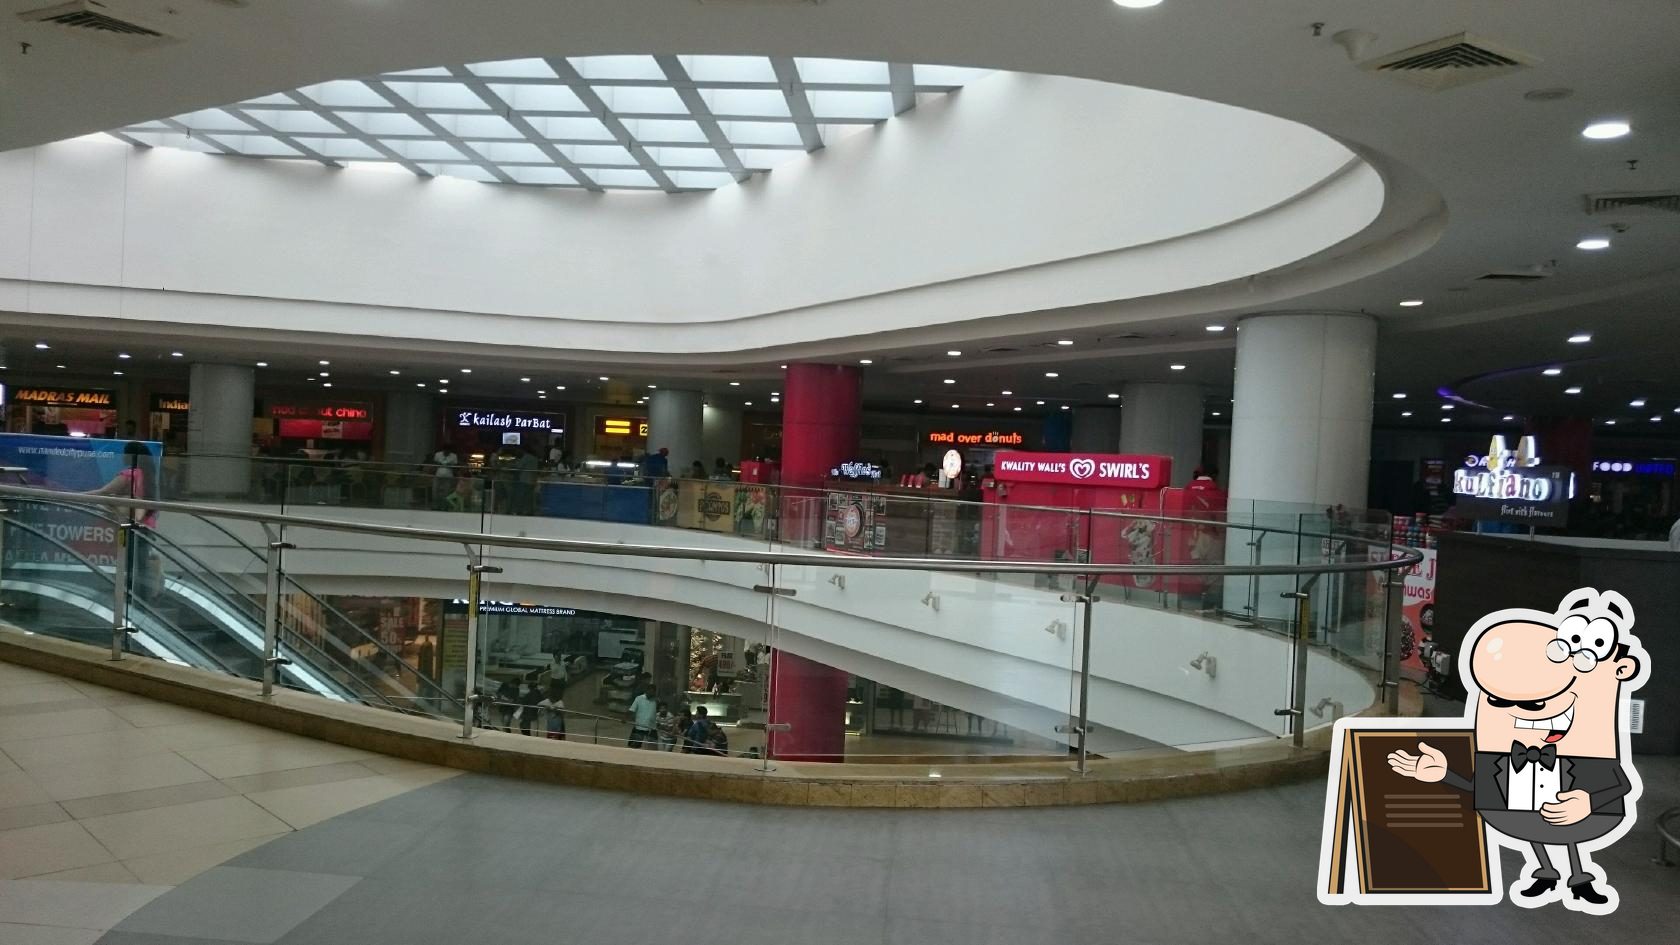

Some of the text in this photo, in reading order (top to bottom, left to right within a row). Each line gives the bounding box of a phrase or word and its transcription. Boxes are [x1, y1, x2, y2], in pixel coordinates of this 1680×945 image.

[16, 390, 110, 404] MADRAS MAIL
[473, 413, 512, 428] kailash
[930, 432, 1022, 445] mad over donuts
[1001, 460, 1150, 480] KWALITY WALL'S SWIRL'S
[1592, 461, 1633, 472] FOOD
[47, 523, 115, 543] TOWERS
